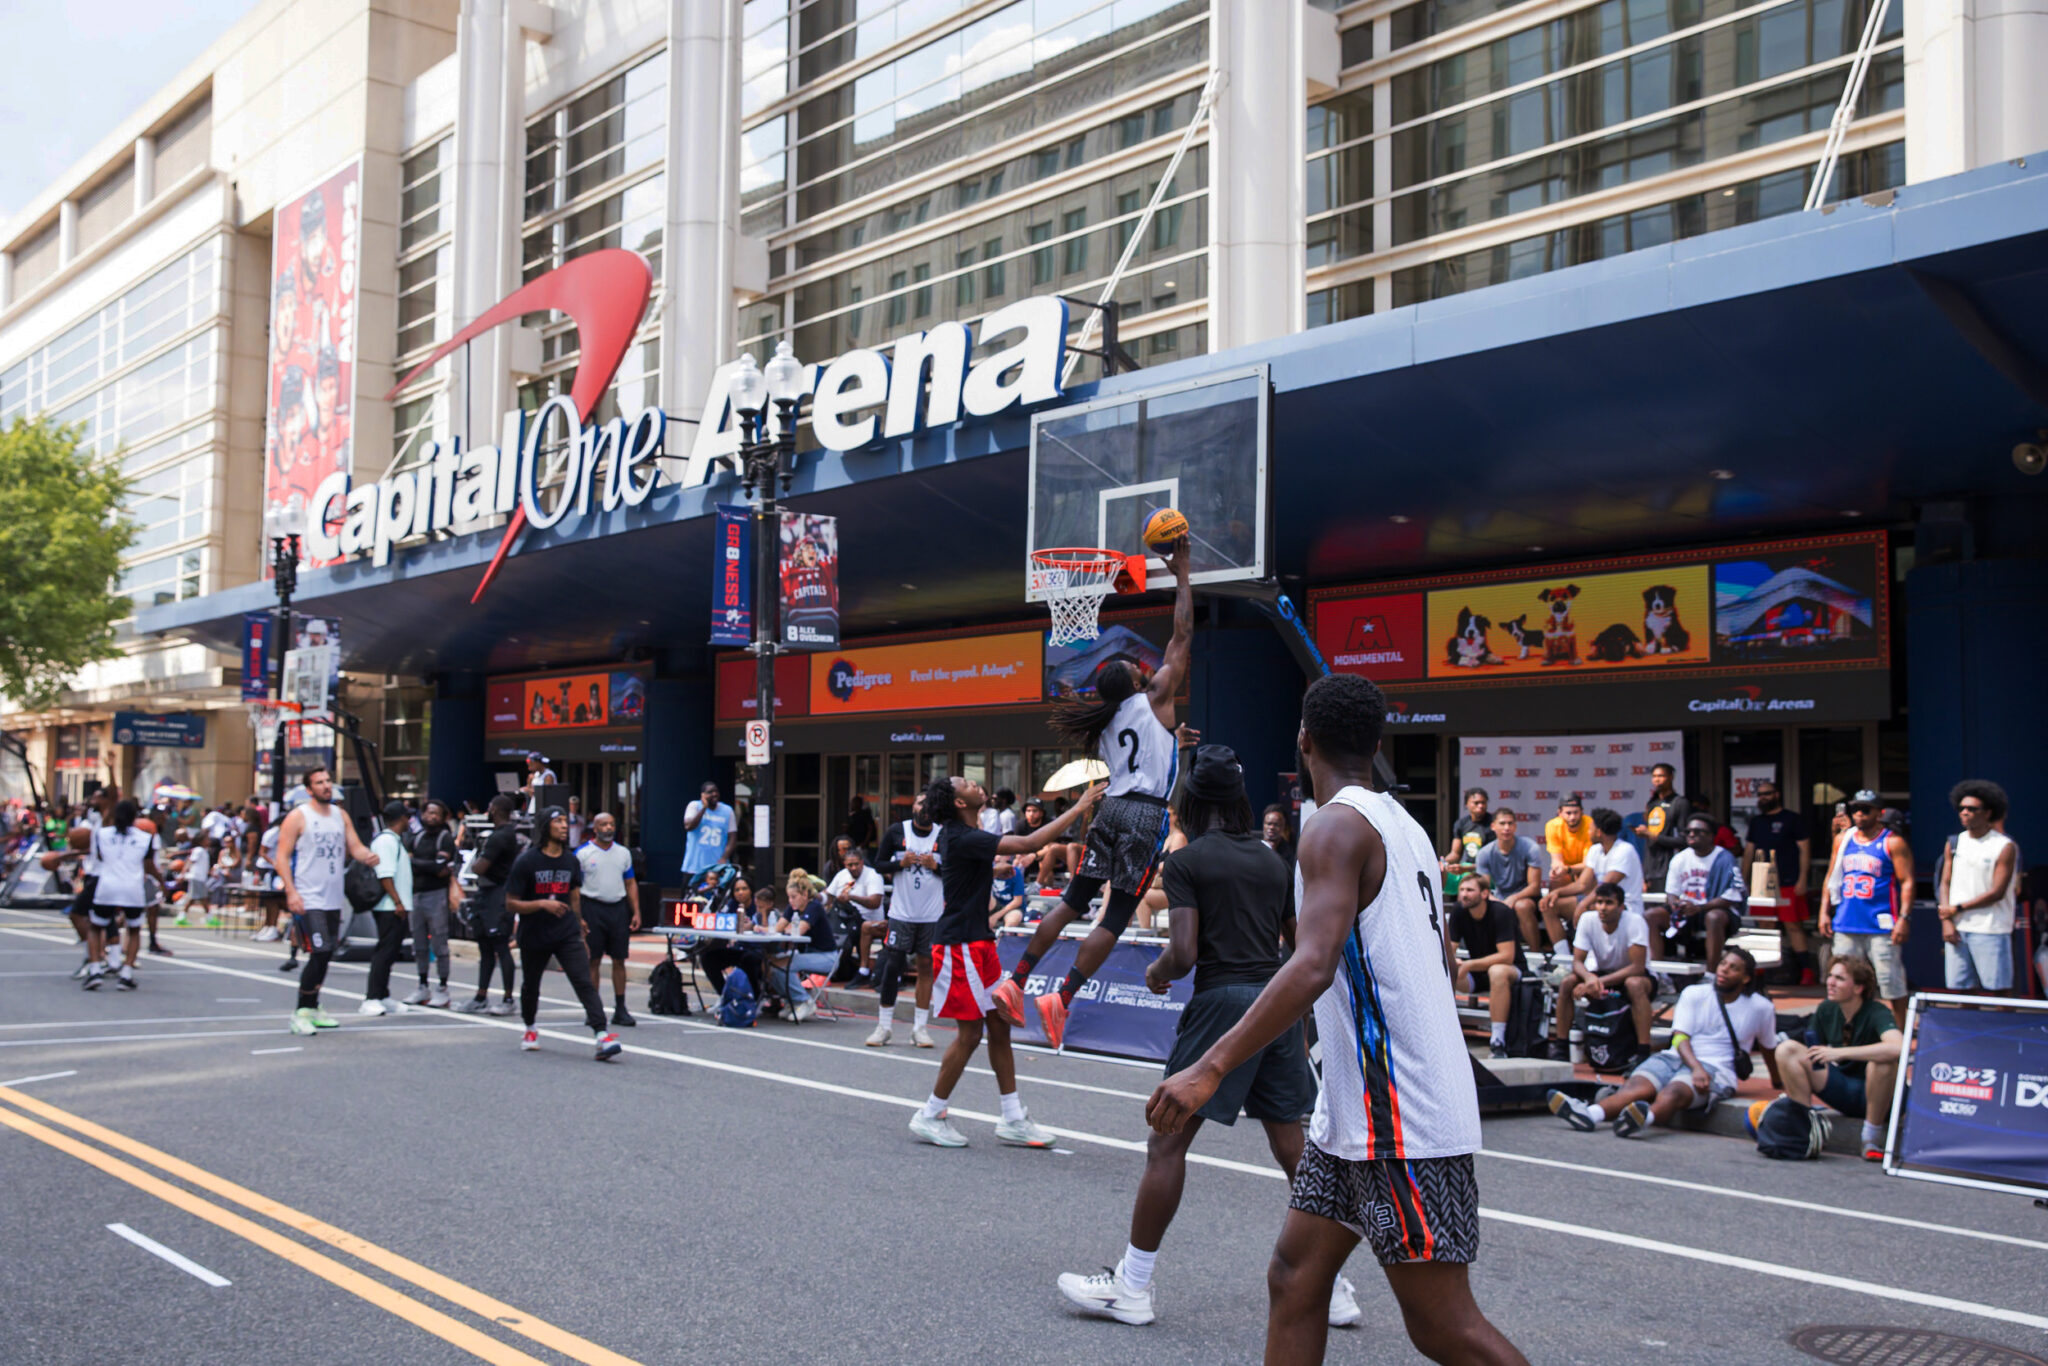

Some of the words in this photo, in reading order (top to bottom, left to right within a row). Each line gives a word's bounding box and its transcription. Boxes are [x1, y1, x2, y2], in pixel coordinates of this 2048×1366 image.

[680, 295, 1069, 489] Arena
[793, 584, 827, 600] CAPITALS
[1333, 652, 1404, 666] MONUMENTAL
[834, 669, 892, 690] Pedigree
[910, 669, 932, 682] Feed
[934, 667, 950, 680] the
[951, 665, 979, 682] good.
[1767, 699, 1815, 710] Arena
[1411, 713, 1446, 723] Arena
[1118, 728, 1140, 773] 2
[699, 825, 721, 847] 25
[1087, 849, 1097, 867] 2
[914, 877, 921, 890] 5
[1843, 873, 1876, 899] 33
[674, 902, 698, 926] 14
[695, 915, 716, 930] 06
[716, 915, 736, 931] 03
[888, 931, 896, 946] 5
[1950, 1065, 1997, 1087] 3v3
